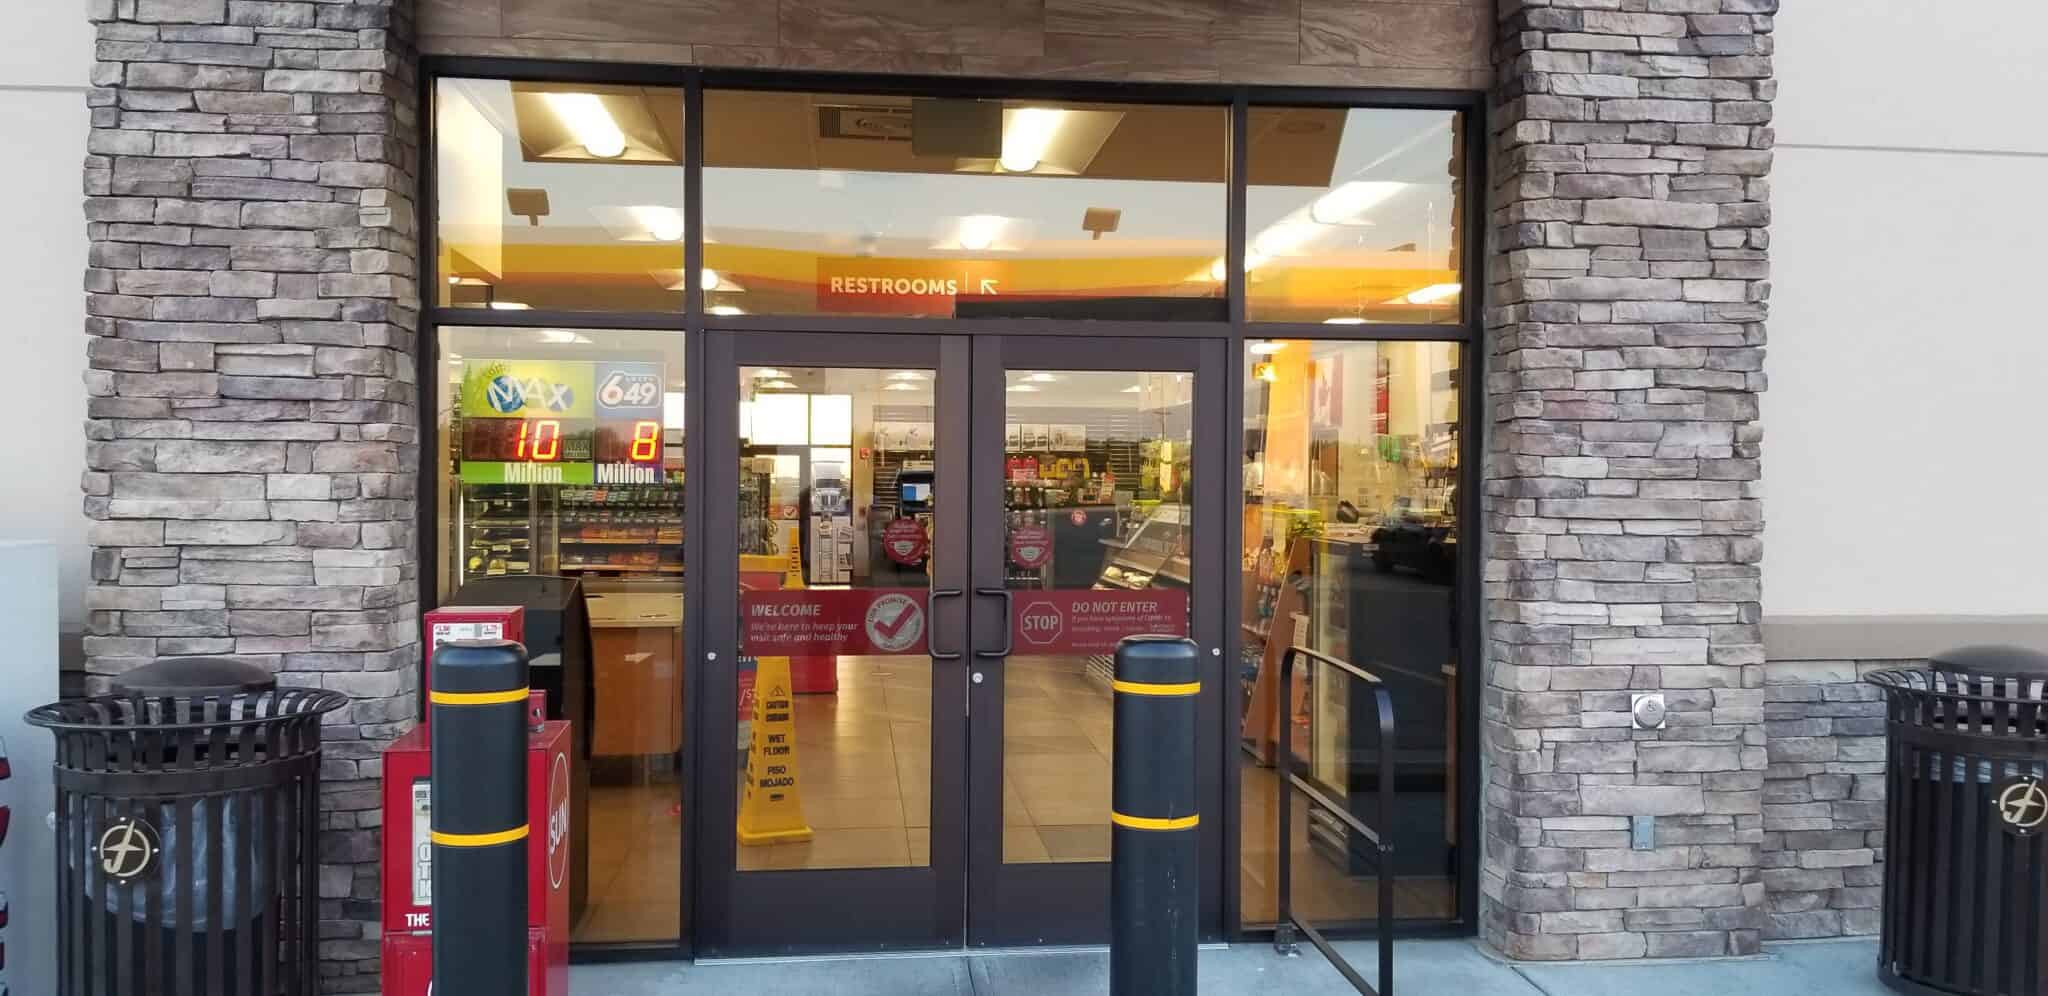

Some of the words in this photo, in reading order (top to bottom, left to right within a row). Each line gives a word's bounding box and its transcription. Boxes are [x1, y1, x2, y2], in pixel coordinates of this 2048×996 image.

[831, 277, 958, 295] RESTROOMS
[487, 376, 569, 413] MAX
[517, 420, 560, 460] 10
[631, 421, 659, 460] 8
[504, 463, 562, 484] Million
[597, 463, 655, 484] Million
[751, 604, 821, 616] WELCOME
[1072, 602, 1090, 613] DO
[1092, 602, 1118, 613] NOT
[1120, 602, 1158, 613] ENTER
[778, 623, 799, 632] here
[836, 623, 857, 633] your
[1024, 615, 1058, 631] STOP
[793, 632, 812, 641] and
[813, 631, 849, 643] healthy
[768, 733, 786, 744] WET
[763, 745, 790, 757] FLOOR
[768, 766, 786, 775] PISO
[759, 776, 794, 788] MOJADO
[548, 797, 567, 855] SUN
[405, 913, 430, 928] THE
